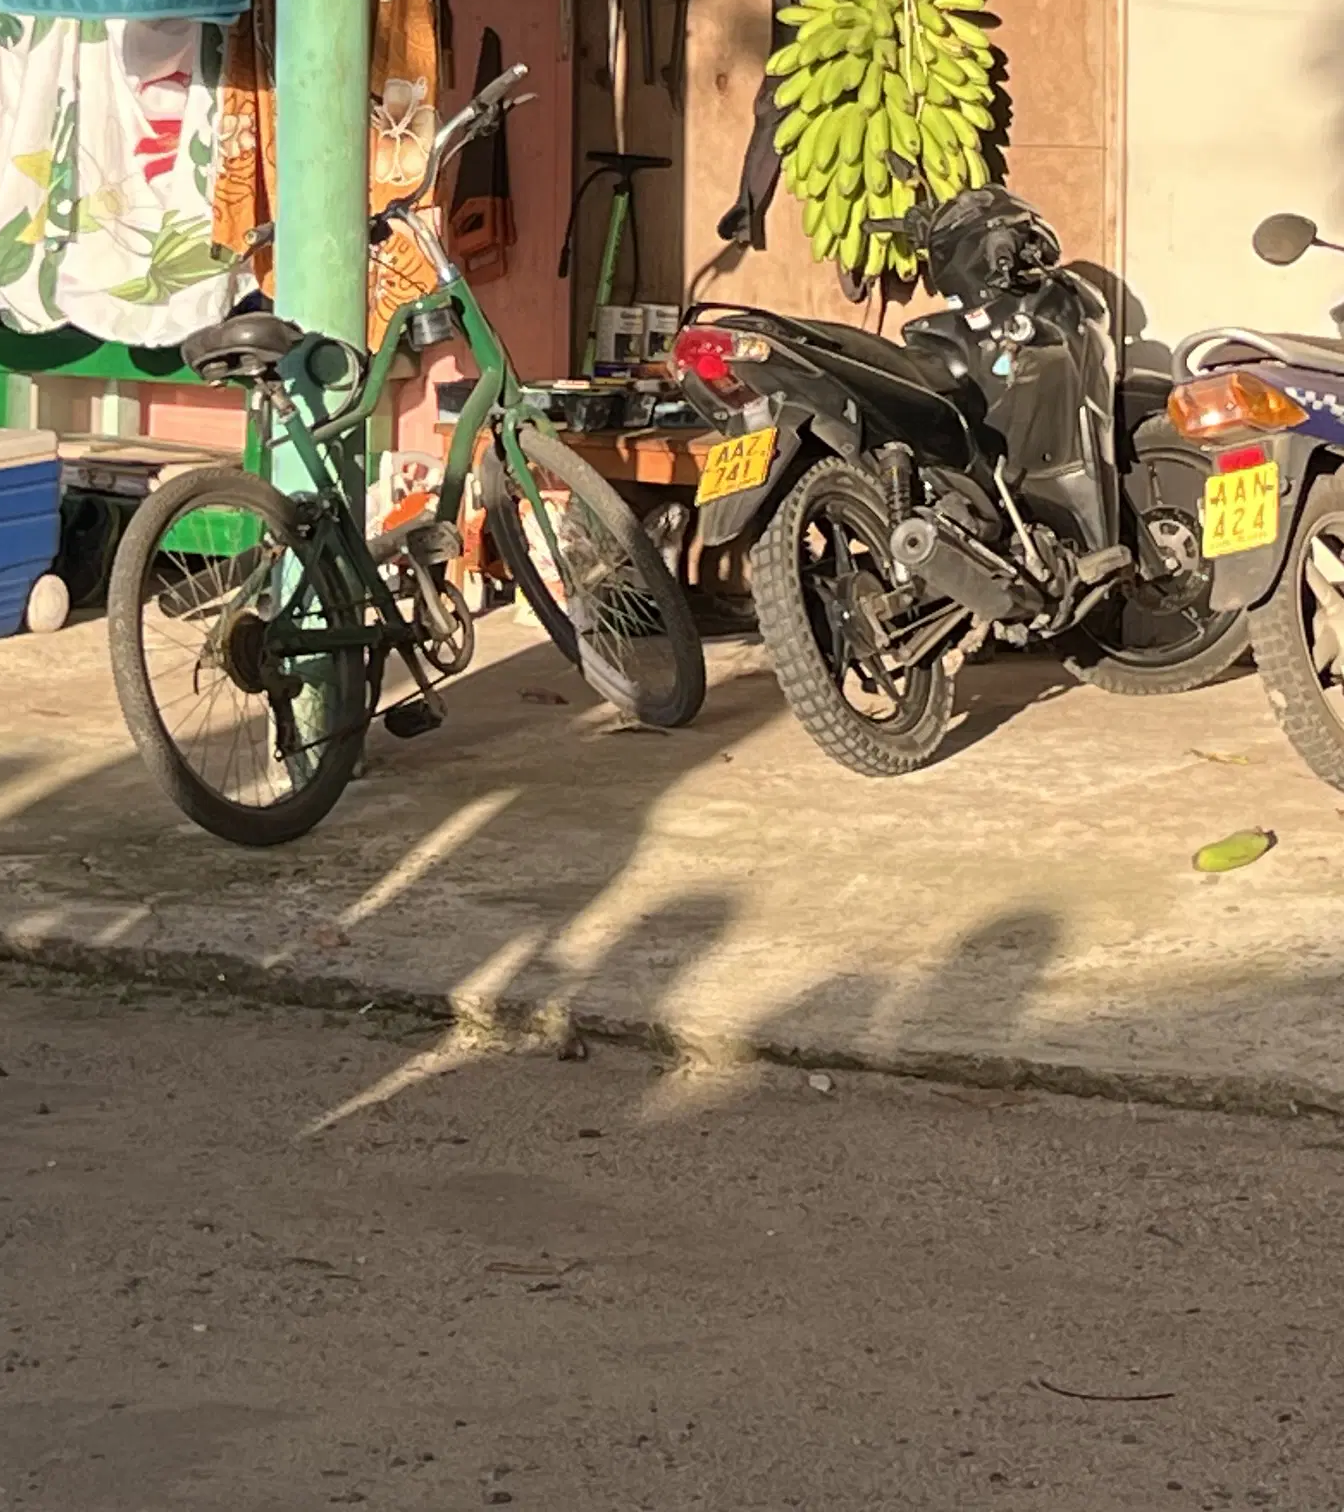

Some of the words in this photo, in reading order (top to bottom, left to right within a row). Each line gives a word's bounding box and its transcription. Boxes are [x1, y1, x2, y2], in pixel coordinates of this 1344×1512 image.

[715, 436, 761, 466] AAZ
[715, 459, 750, 485] 741
[1215, 471, 1268, 506] AAN
[1212, 502, 1264, 539] 424
